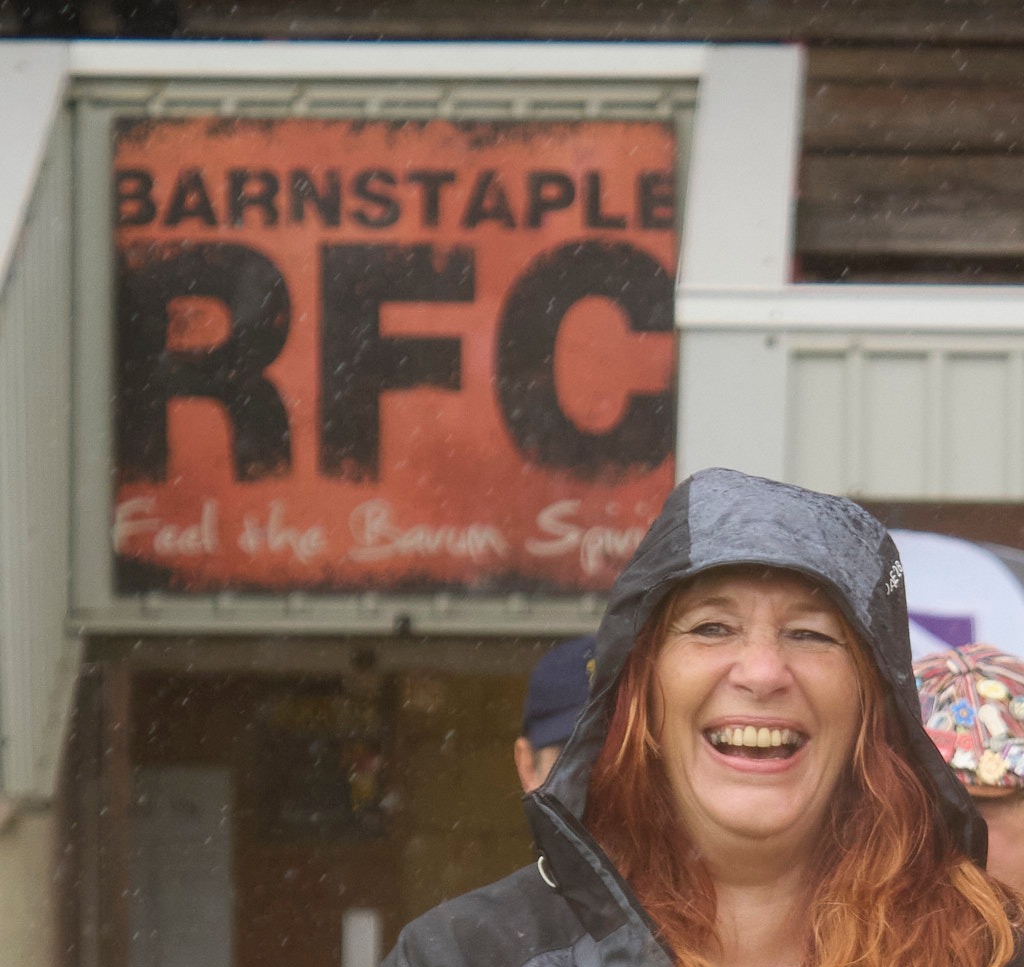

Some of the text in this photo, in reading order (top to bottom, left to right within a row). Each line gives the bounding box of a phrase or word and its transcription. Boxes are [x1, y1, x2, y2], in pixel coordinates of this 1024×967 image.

[114, 167, 675, 230] BARNSTAPLE
[114, 240, 675, 484] RFC
[113, 499, 218, 556] Feel
[238, 500, 328, 560] the
